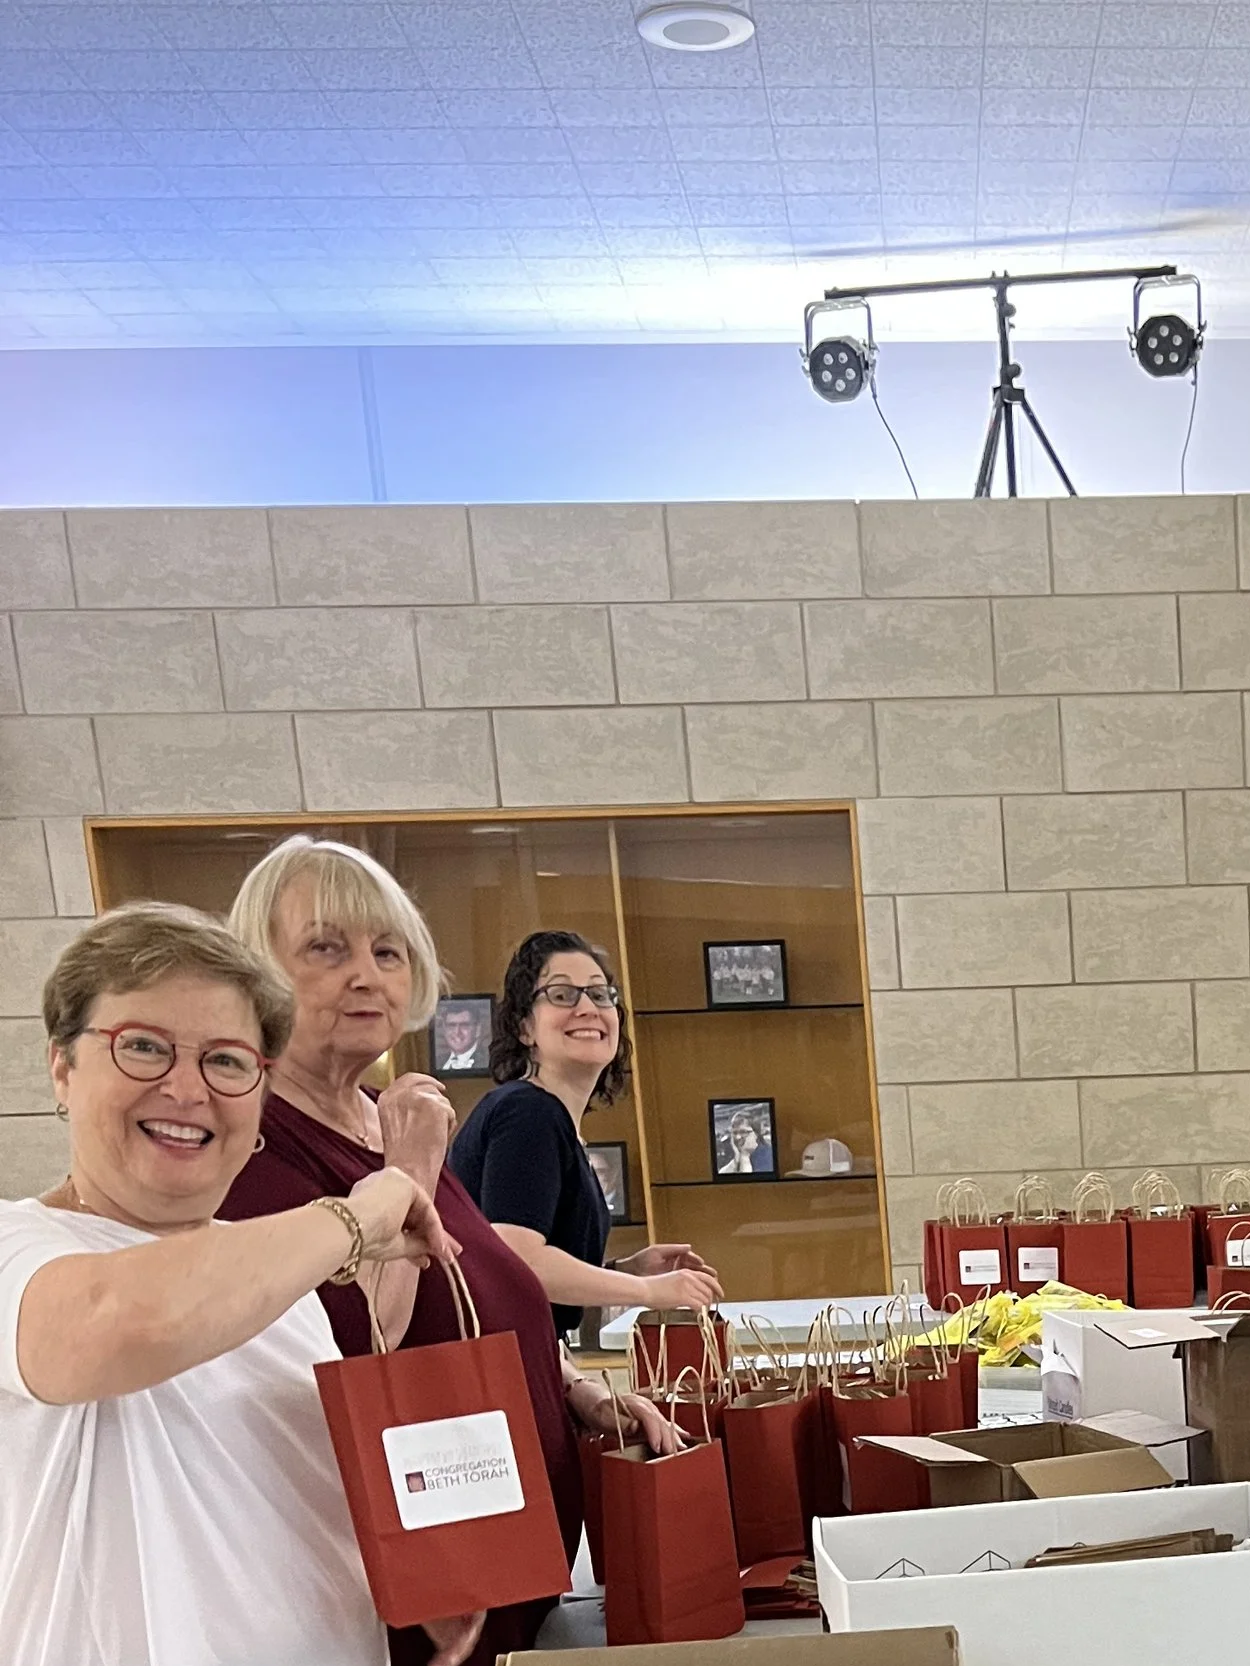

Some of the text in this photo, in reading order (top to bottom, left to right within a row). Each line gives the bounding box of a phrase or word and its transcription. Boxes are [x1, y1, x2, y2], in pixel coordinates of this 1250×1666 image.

[425, 1457, 507, 1478] CONGREGATION
[428, 1467, 509, 1491] BETH TORAH
